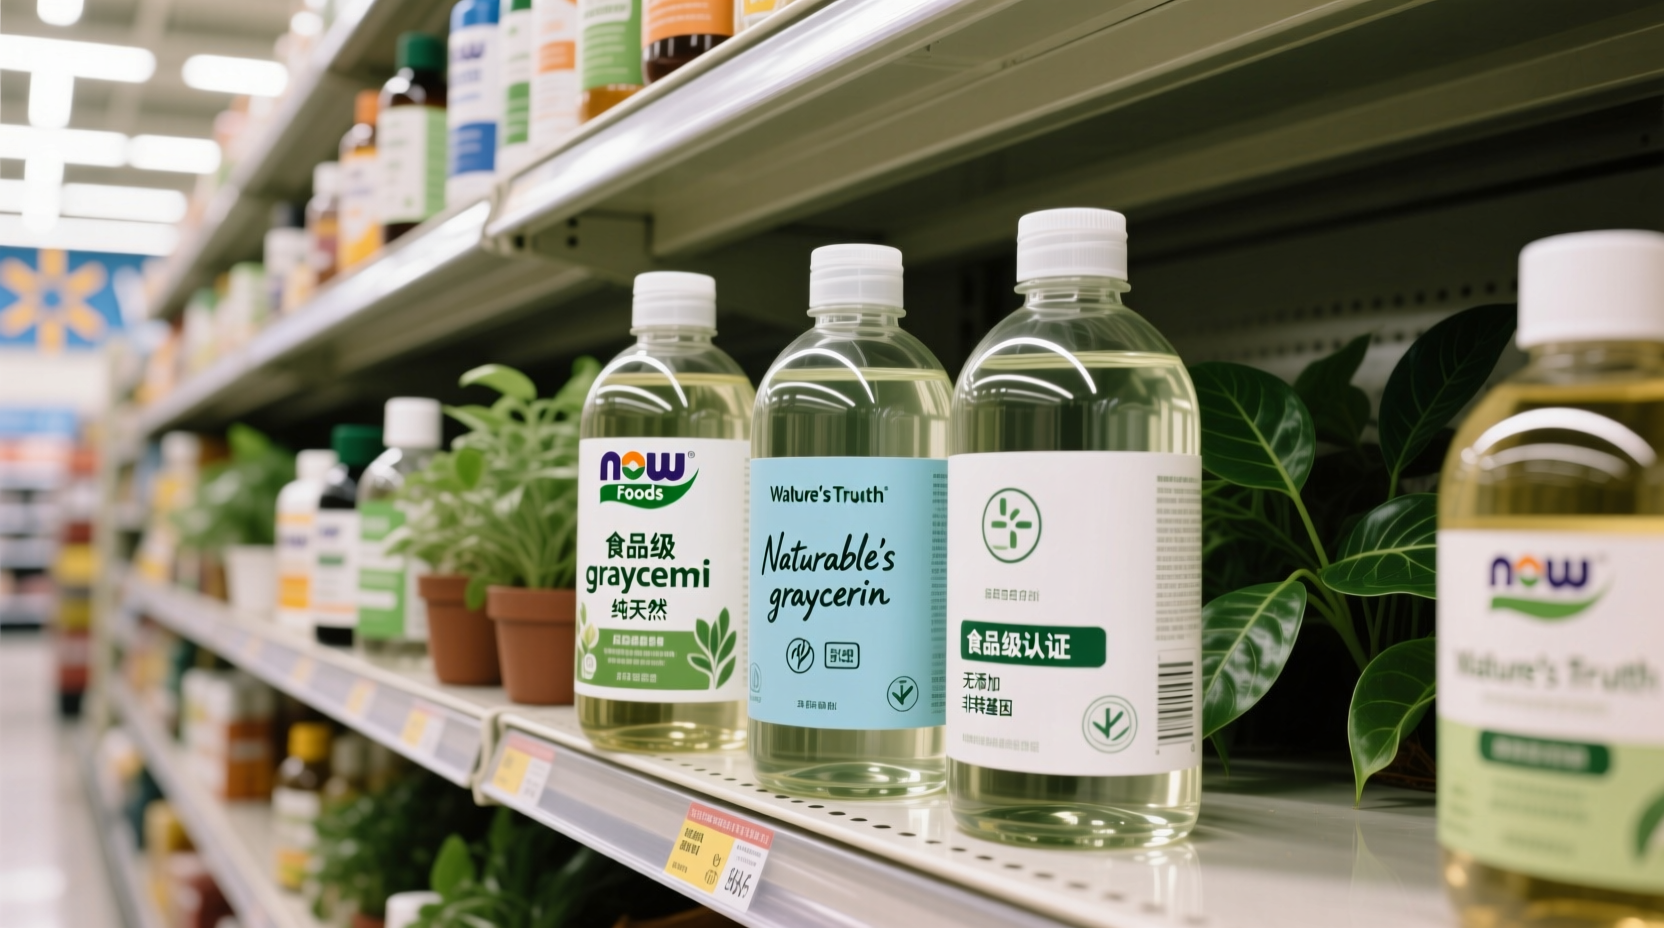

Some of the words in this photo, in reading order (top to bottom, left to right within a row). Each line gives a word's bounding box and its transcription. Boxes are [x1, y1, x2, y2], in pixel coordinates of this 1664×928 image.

[617, 484, 664, 501] Foods
[606, 531, 676, 560] 食品级
[761, 531, 896, 576] Naturable's
[586, 559, 711, 594] graycemi
[611, 598, 668, 621] 纯天然
[767, 579, 891, 624] graycerin
[967, 629, 1071, 660] 食品级认证
